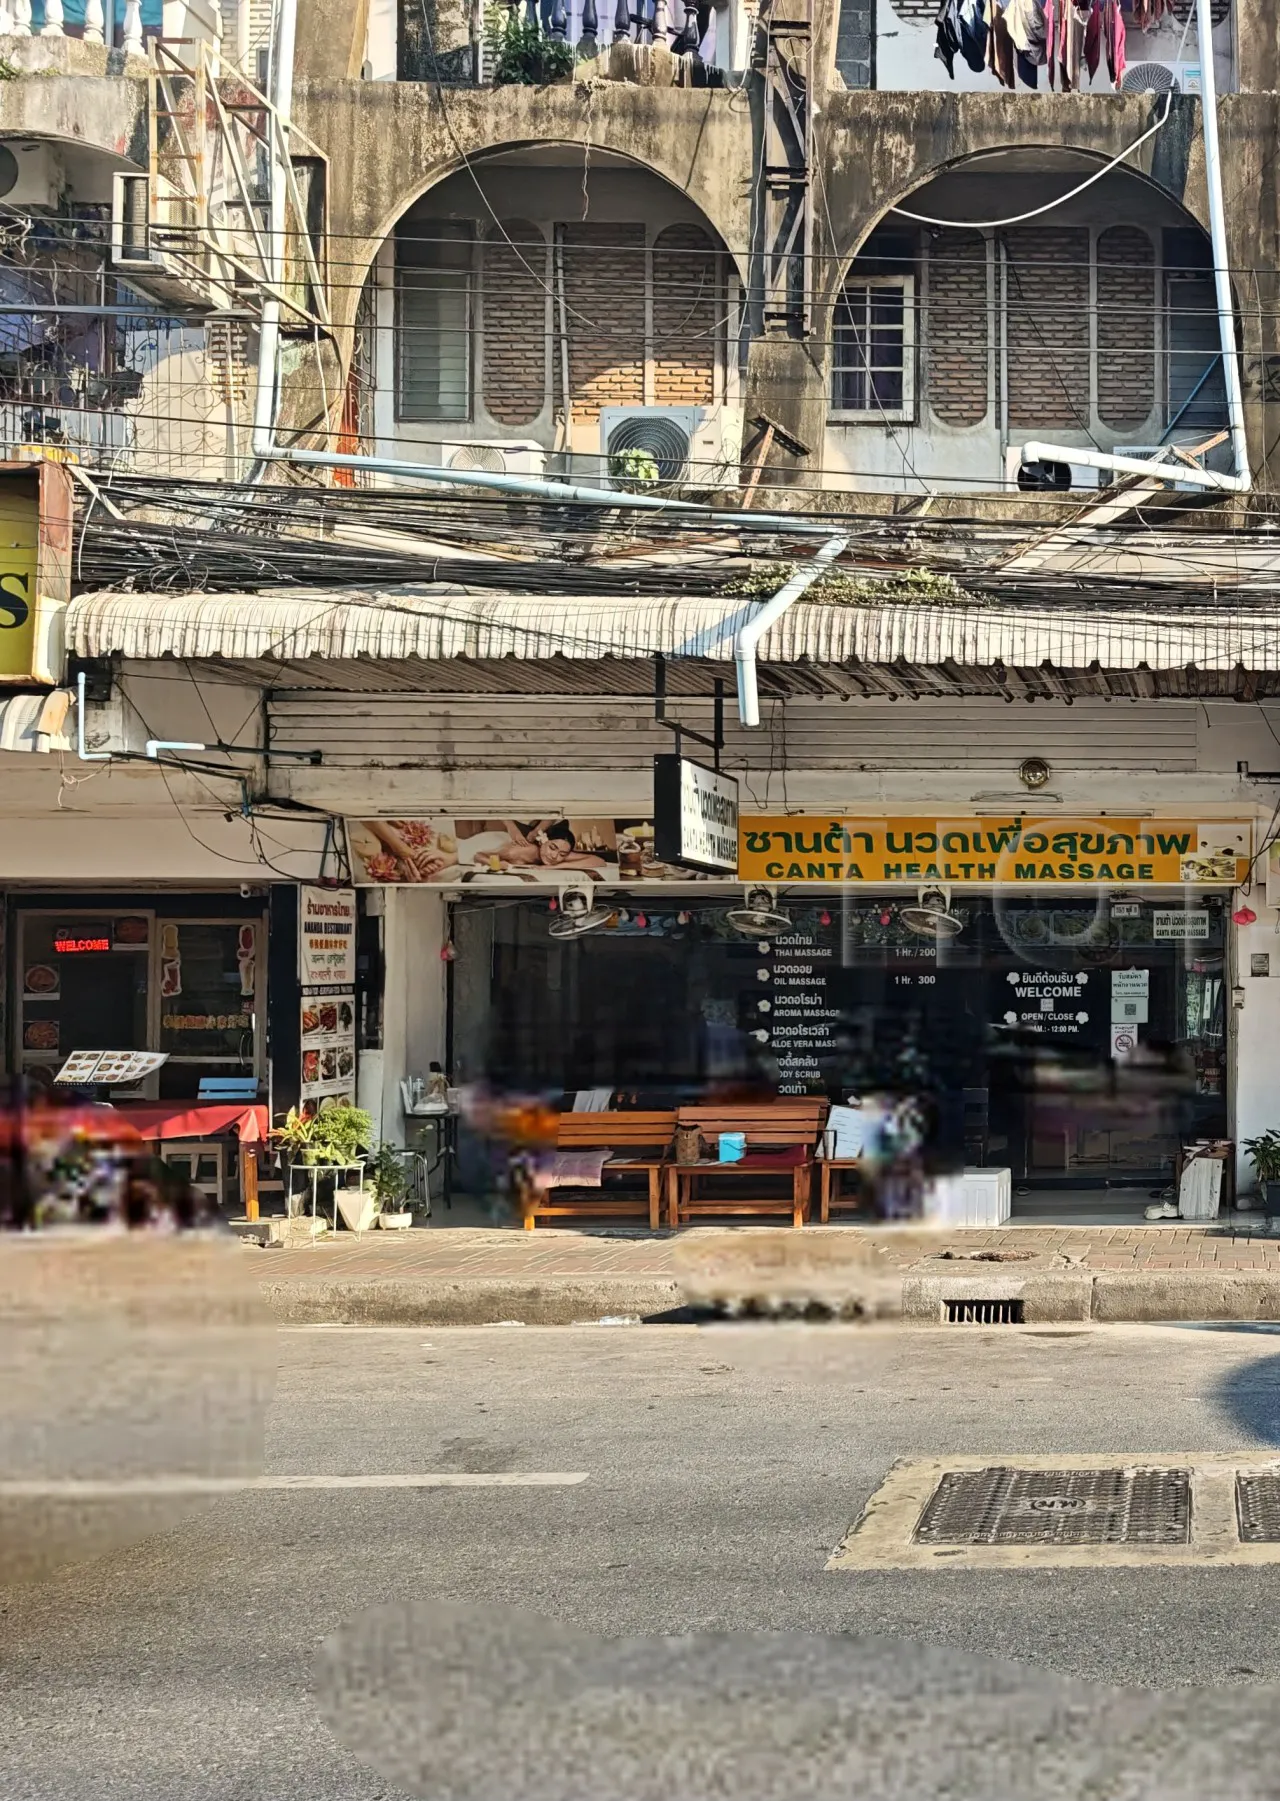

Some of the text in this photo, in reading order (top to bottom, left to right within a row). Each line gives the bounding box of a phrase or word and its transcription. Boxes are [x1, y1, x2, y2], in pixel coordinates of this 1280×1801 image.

[0, 572, 29, 629] S
[743, 817, 1190, 861] ชานต้า นวดเพื่อสุขภาพ
[765, 862, 1153, 879] CANTA HEALTH MASSAGE
[55, 939, 109, 952] WELCOME
[775, 934, 812, 945] นวดไทย
[773, 964, 812, 974] นวดออย
[918, 976, 936, 984] 300
[1022, 971, 1073, 984] ยินดีต้อนรับ
[1015, 986, 1082, 997] WELCOME
[773, 1009, 802, 1017] AROMA
[1051, 1025, 1067, 1033] 12:00
[771, 1040, 792, 1048] ALOE
[793, 1040, 814, 1048] VERA
[776, 1051, 818, 1067] อดี้สคลับ
[778, 1081, 807, 1094] วดเท้า
